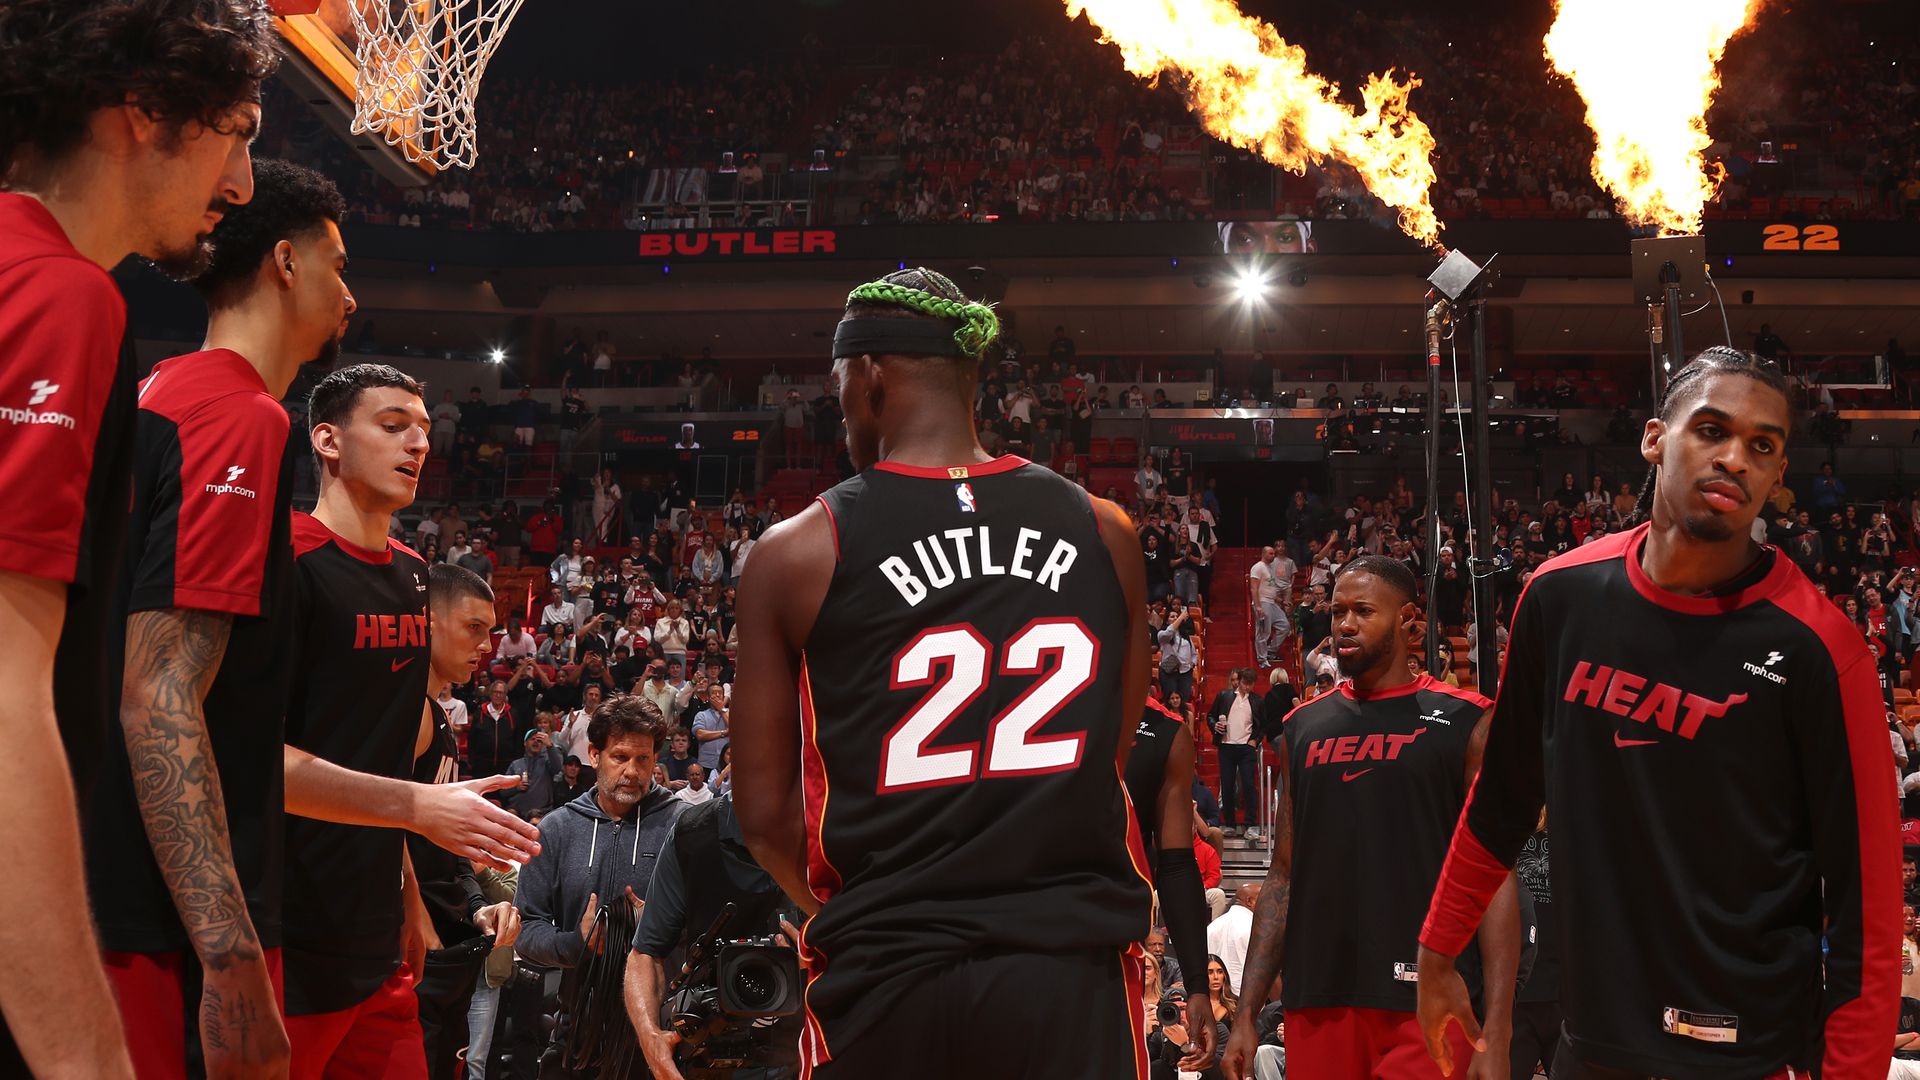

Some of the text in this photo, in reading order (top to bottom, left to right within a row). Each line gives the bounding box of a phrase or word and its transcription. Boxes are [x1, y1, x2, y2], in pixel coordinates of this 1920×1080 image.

[639, 230, 837, 257] BUTLER
[1762, 223, 1840, 251] 22
[731, 430, 760, 441] 22
[206, 483, 256, 499] mph.com
[878, 526, 1078, 608] BUTLER
[641, 603, 653, 611] 22
[353, 605, 428, 649] HEAT
[876, 616, 1102, 796] 22
[1563, 660, 1750, 741] HEAT
[1419, 715, 1451, 726] mph.com
[1305, 727, 1428, 769] HEAT
